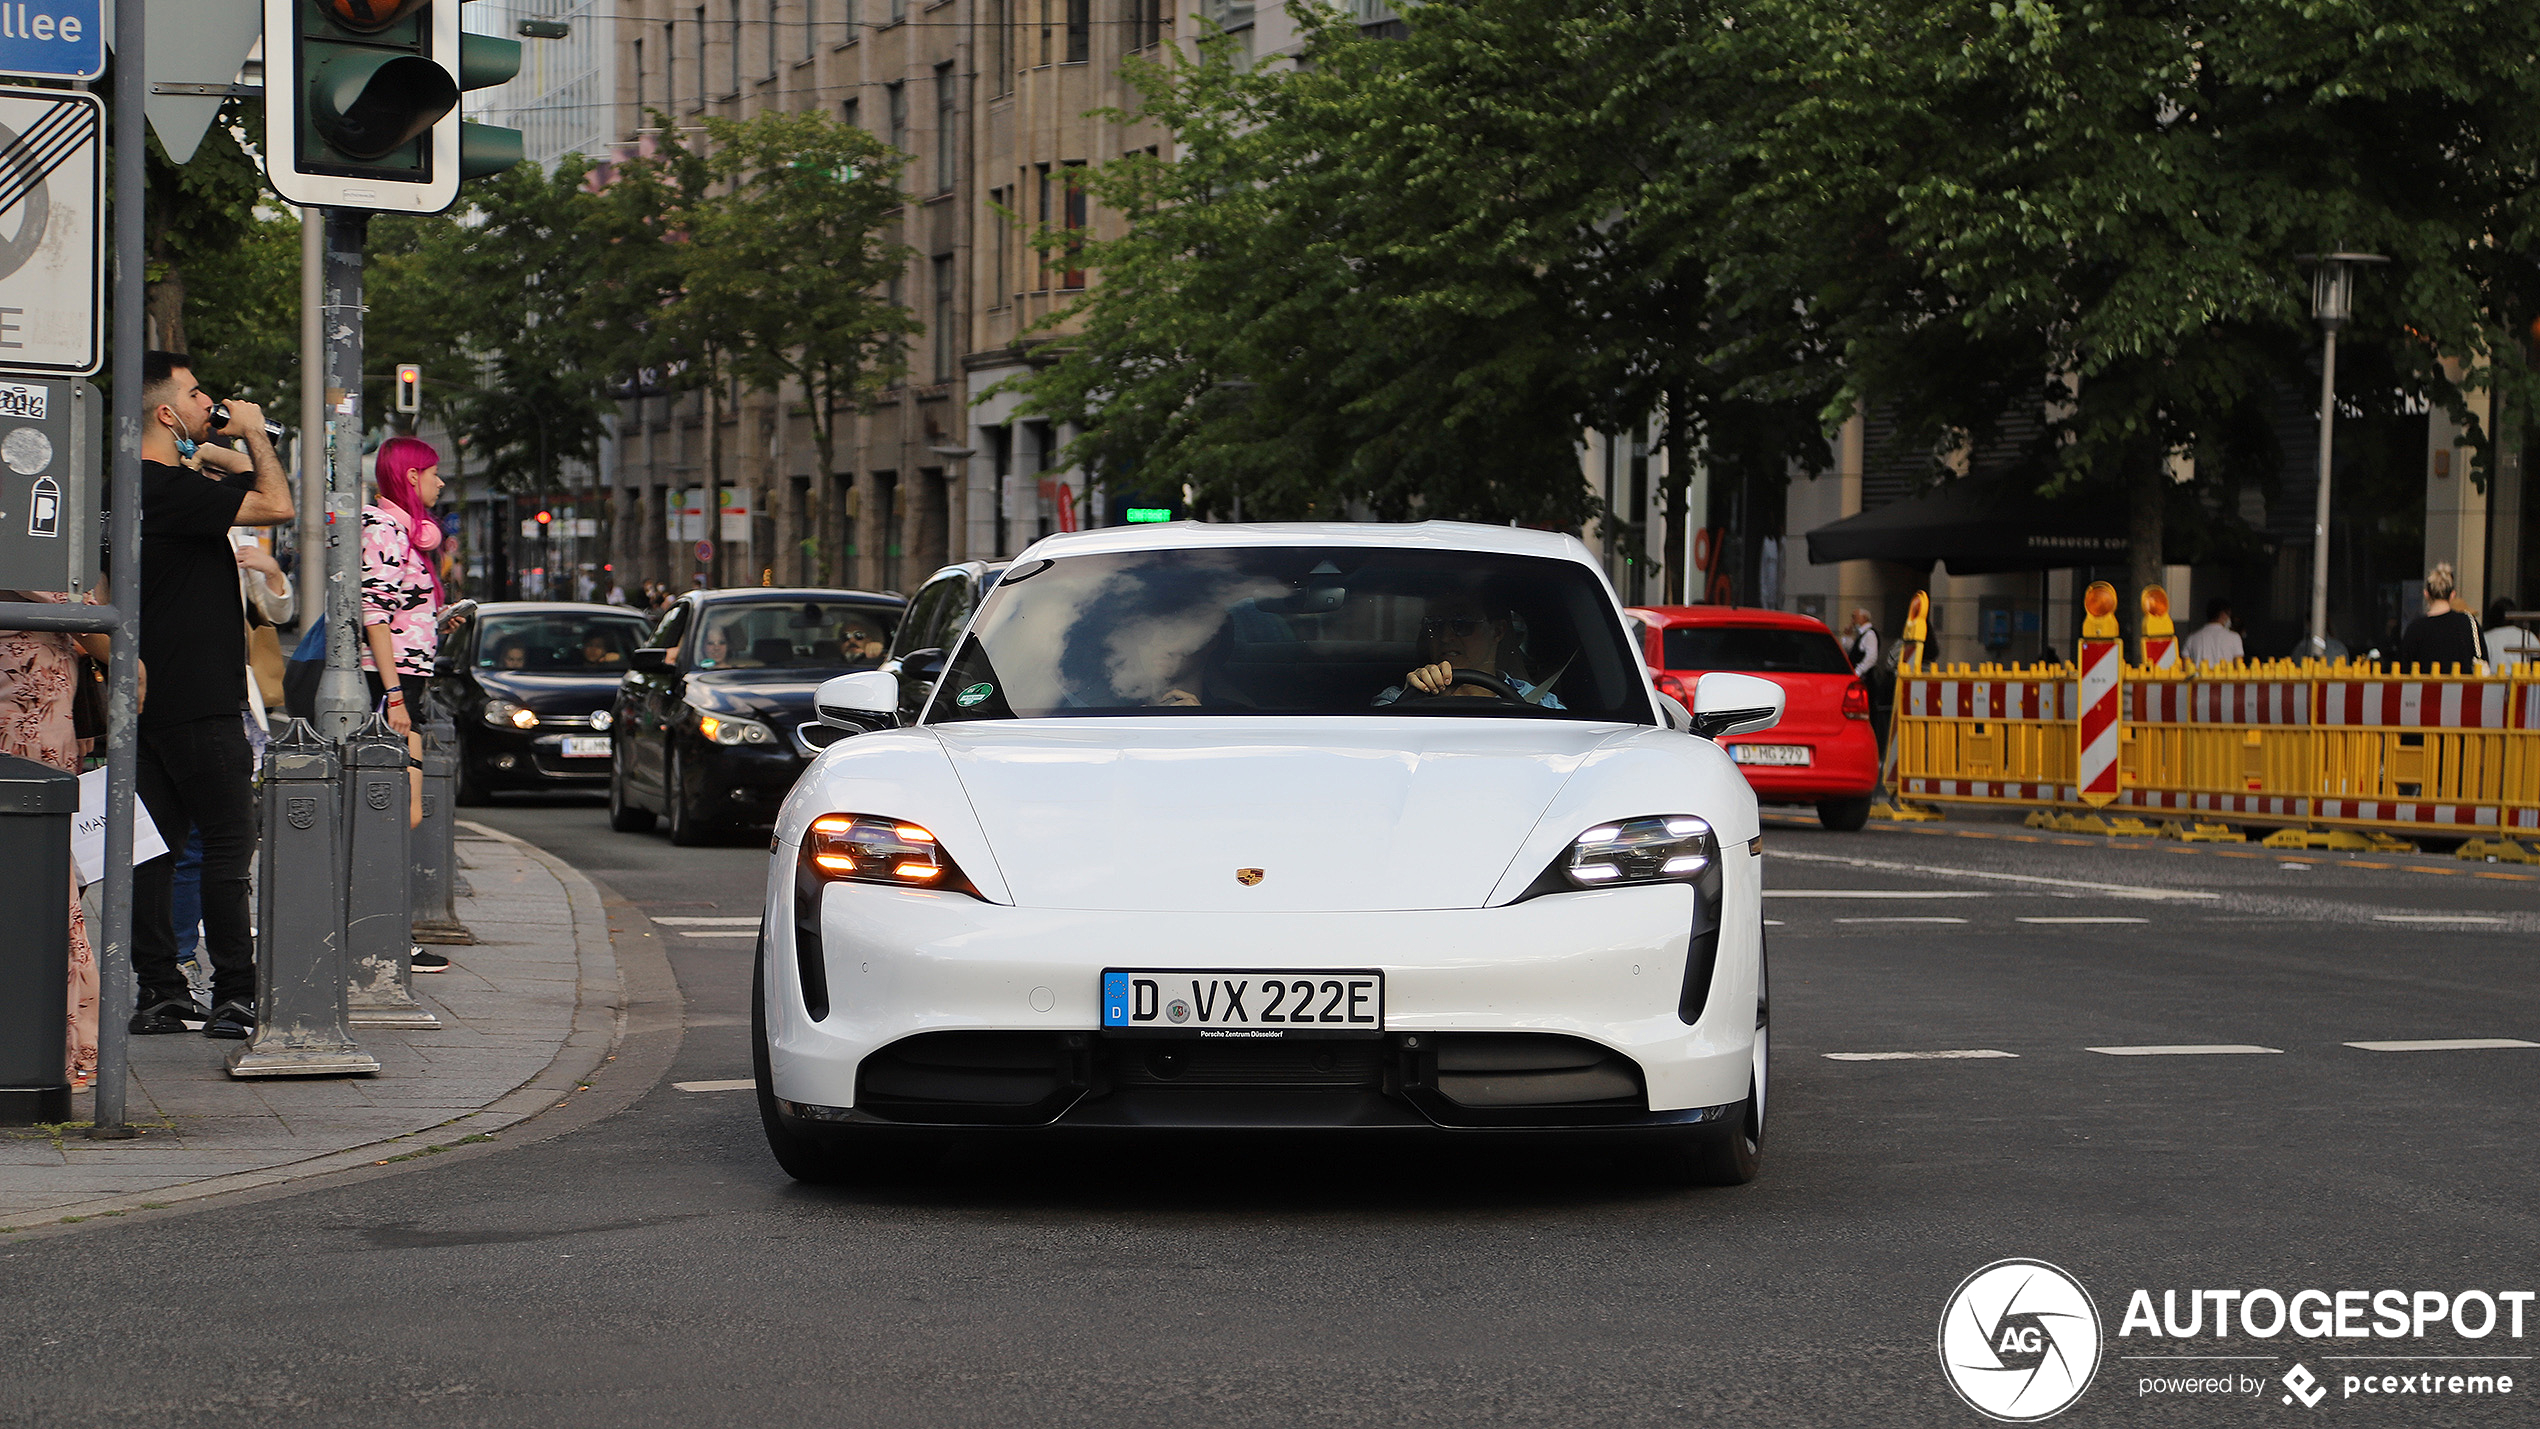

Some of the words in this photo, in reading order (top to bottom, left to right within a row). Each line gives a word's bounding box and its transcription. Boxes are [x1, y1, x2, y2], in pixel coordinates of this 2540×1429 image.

[3, 2, 82, 43] llee
[2028, 535, 2101, 549] STARBUCKS
[1779, 746, 1803, 763] 279
[1132, 979, 1159, 1022] D
[1191, 980, 1249, 1023] VX
[1260, 980, 1375, 1023] 222E
[1200, 1030, 1225, 1038] Porsche
[1225, 1030, 1251, 1038] Zentrum
[1250, 1030, 1284, 1038] Düsseldorf
